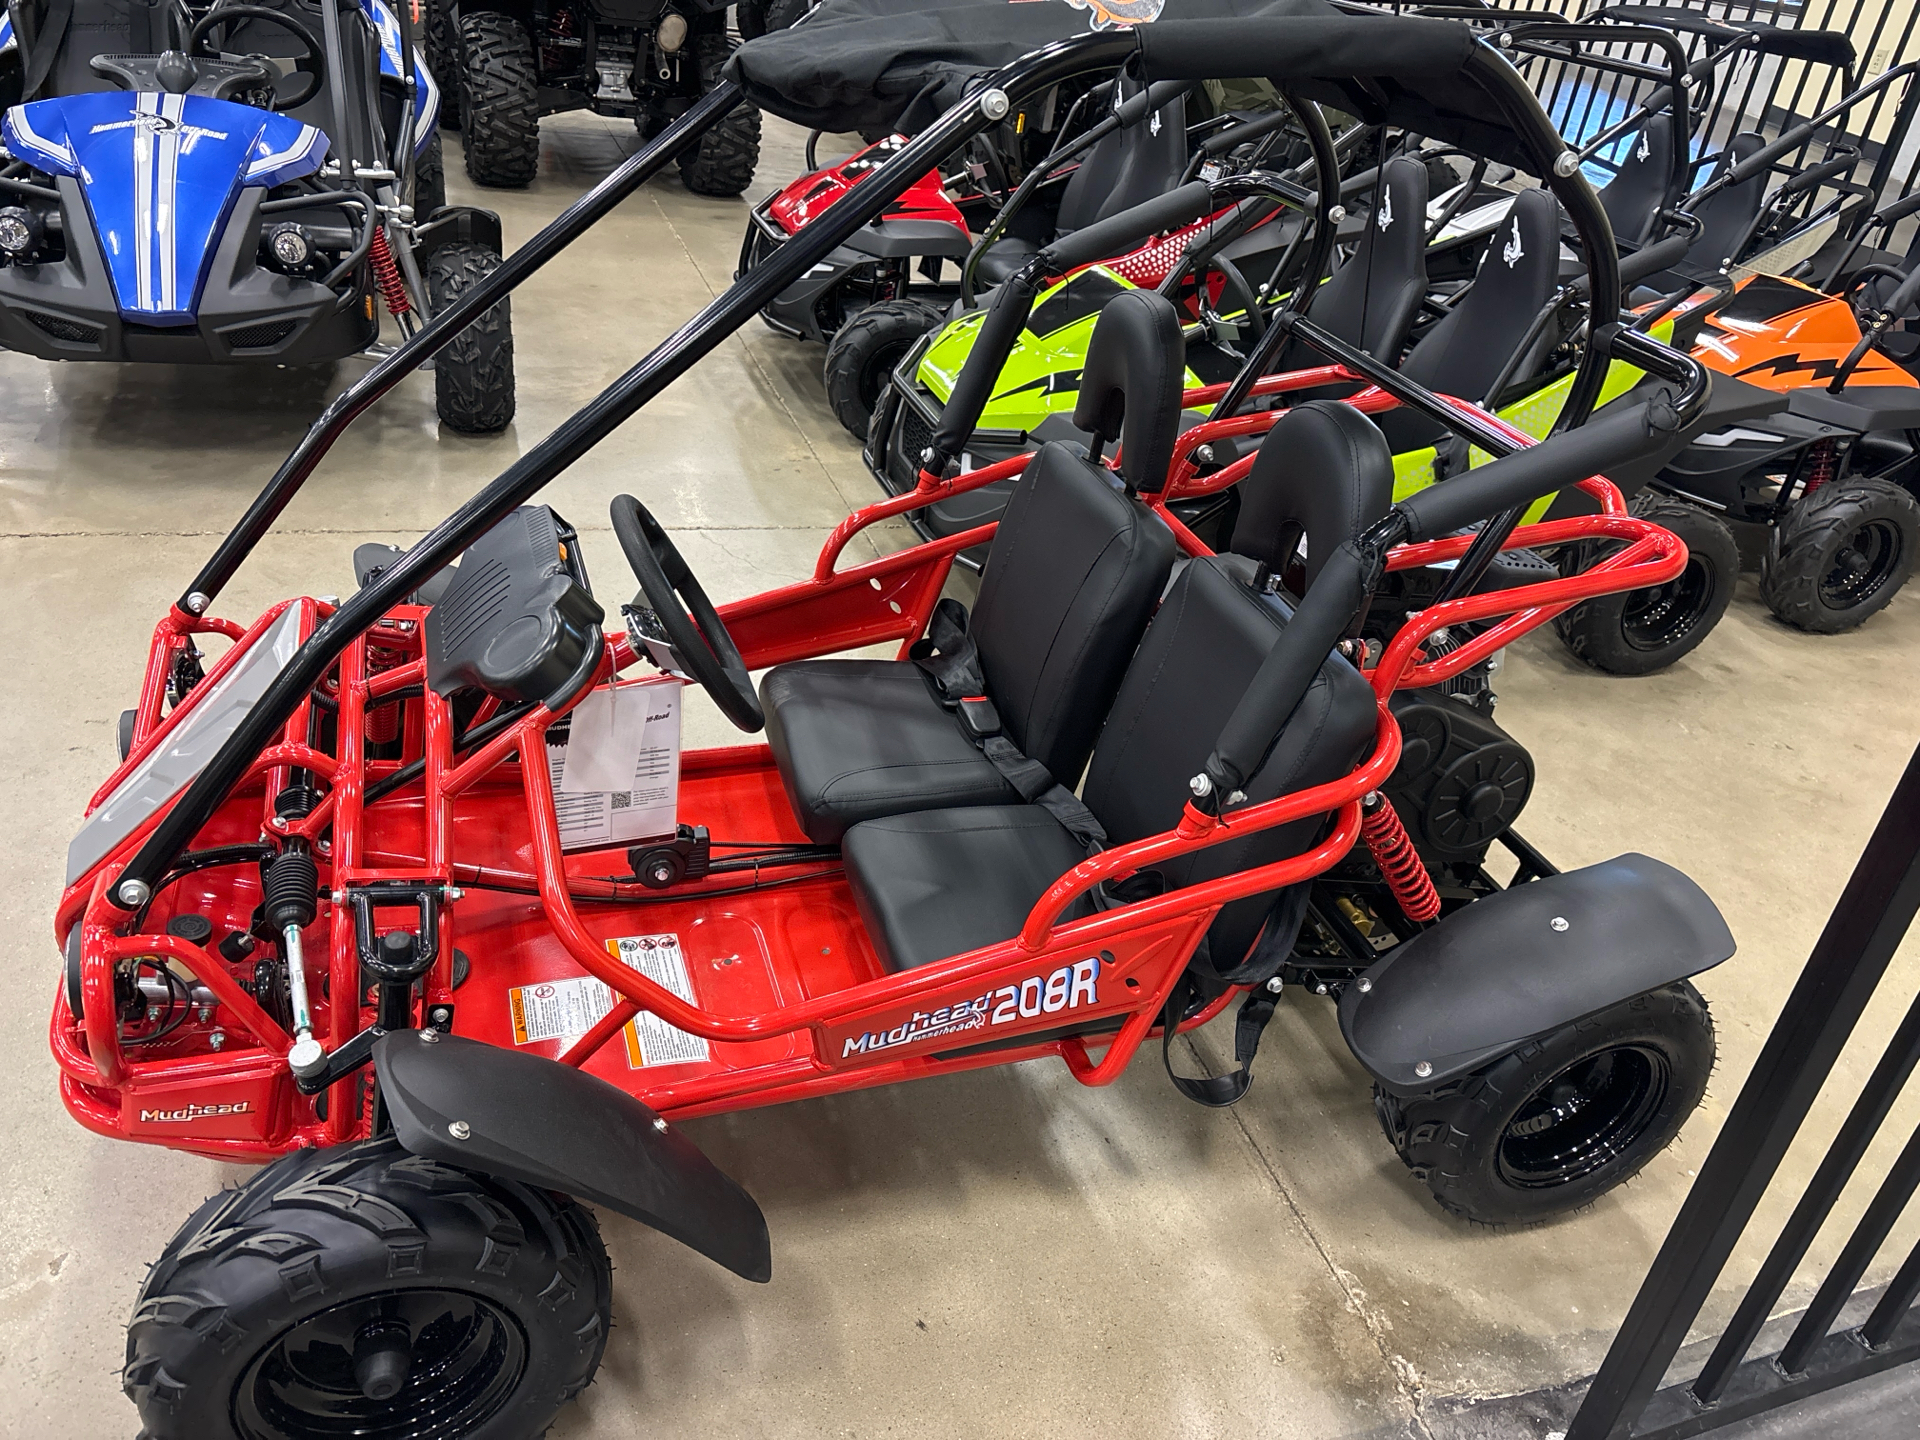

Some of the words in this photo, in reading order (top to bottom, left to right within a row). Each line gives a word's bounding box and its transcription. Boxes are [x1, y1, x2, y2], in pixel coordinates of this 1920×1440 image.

[514, 998, 523, 1026] WARNING
[842, 991, 993, 1059] Mudhead
[991, 956, 1100, 1026] 208R
[912, 1020, 973, 1043] Hammerhead
[139, 1101, 250, 1123] Mudhead
